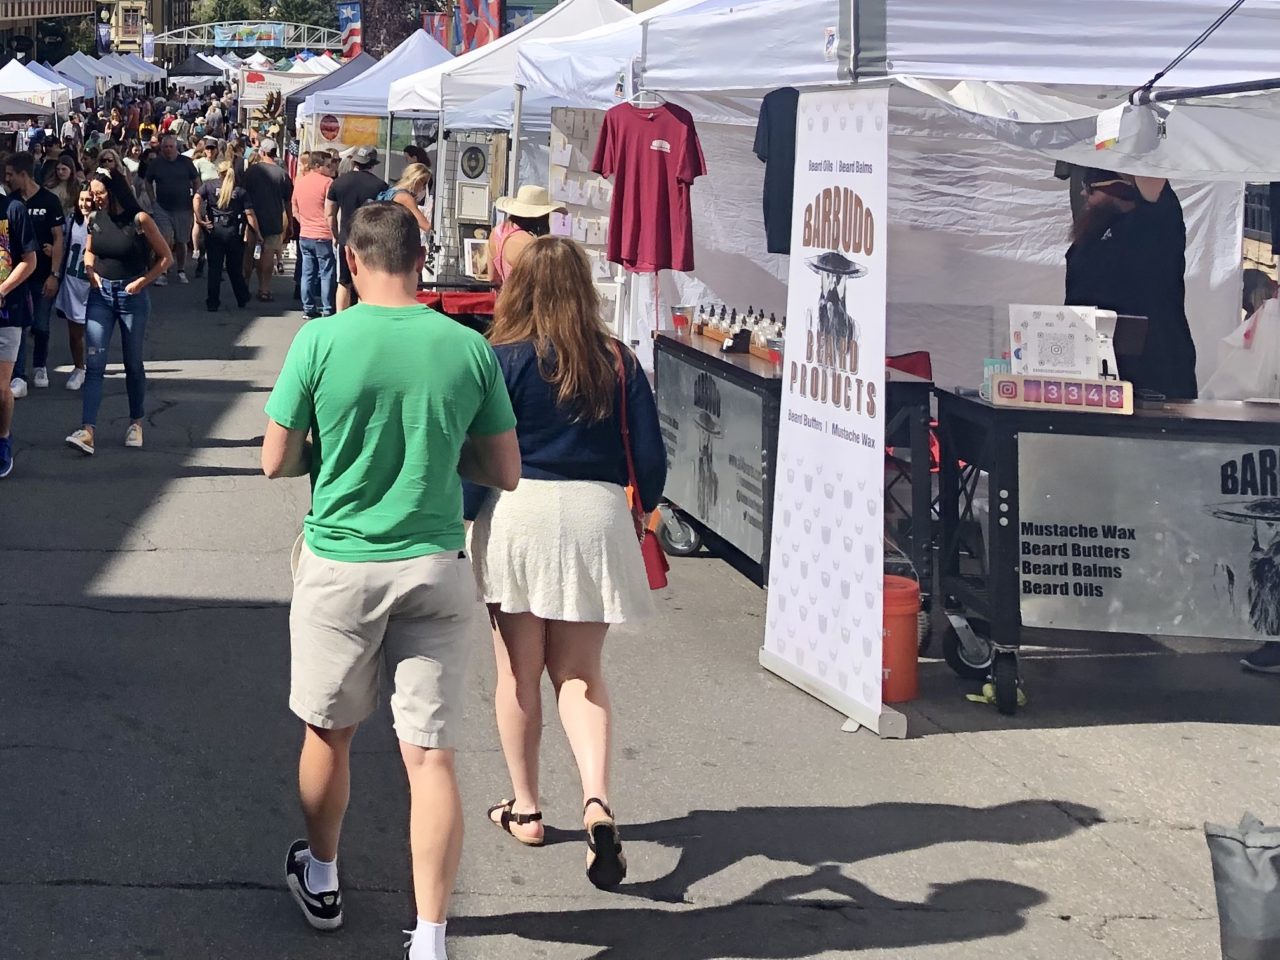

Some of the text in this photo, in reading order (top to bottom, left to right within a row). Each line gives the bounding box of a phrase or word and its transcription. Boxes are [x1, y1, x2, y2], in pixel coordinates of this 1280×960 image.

[838, 161, 854, 173] Beard
[855, 161, 873, 174] Balms
[802, 185, 874, 256] BARBUDO
[806, 329, 859, 375] BEARD
[790, 361, 876, 419] PRODUCTS
[788, 409, 876, 449] Beard Butters Mustache Wax
[1021, 522, 1136, 540] Mustache Wax
[1021, 541, 1130, 559] Beard Butters
[1022, 560, 1122, 578] Beard Balms
[1022, 580, 1104, 597] Beard Oils
